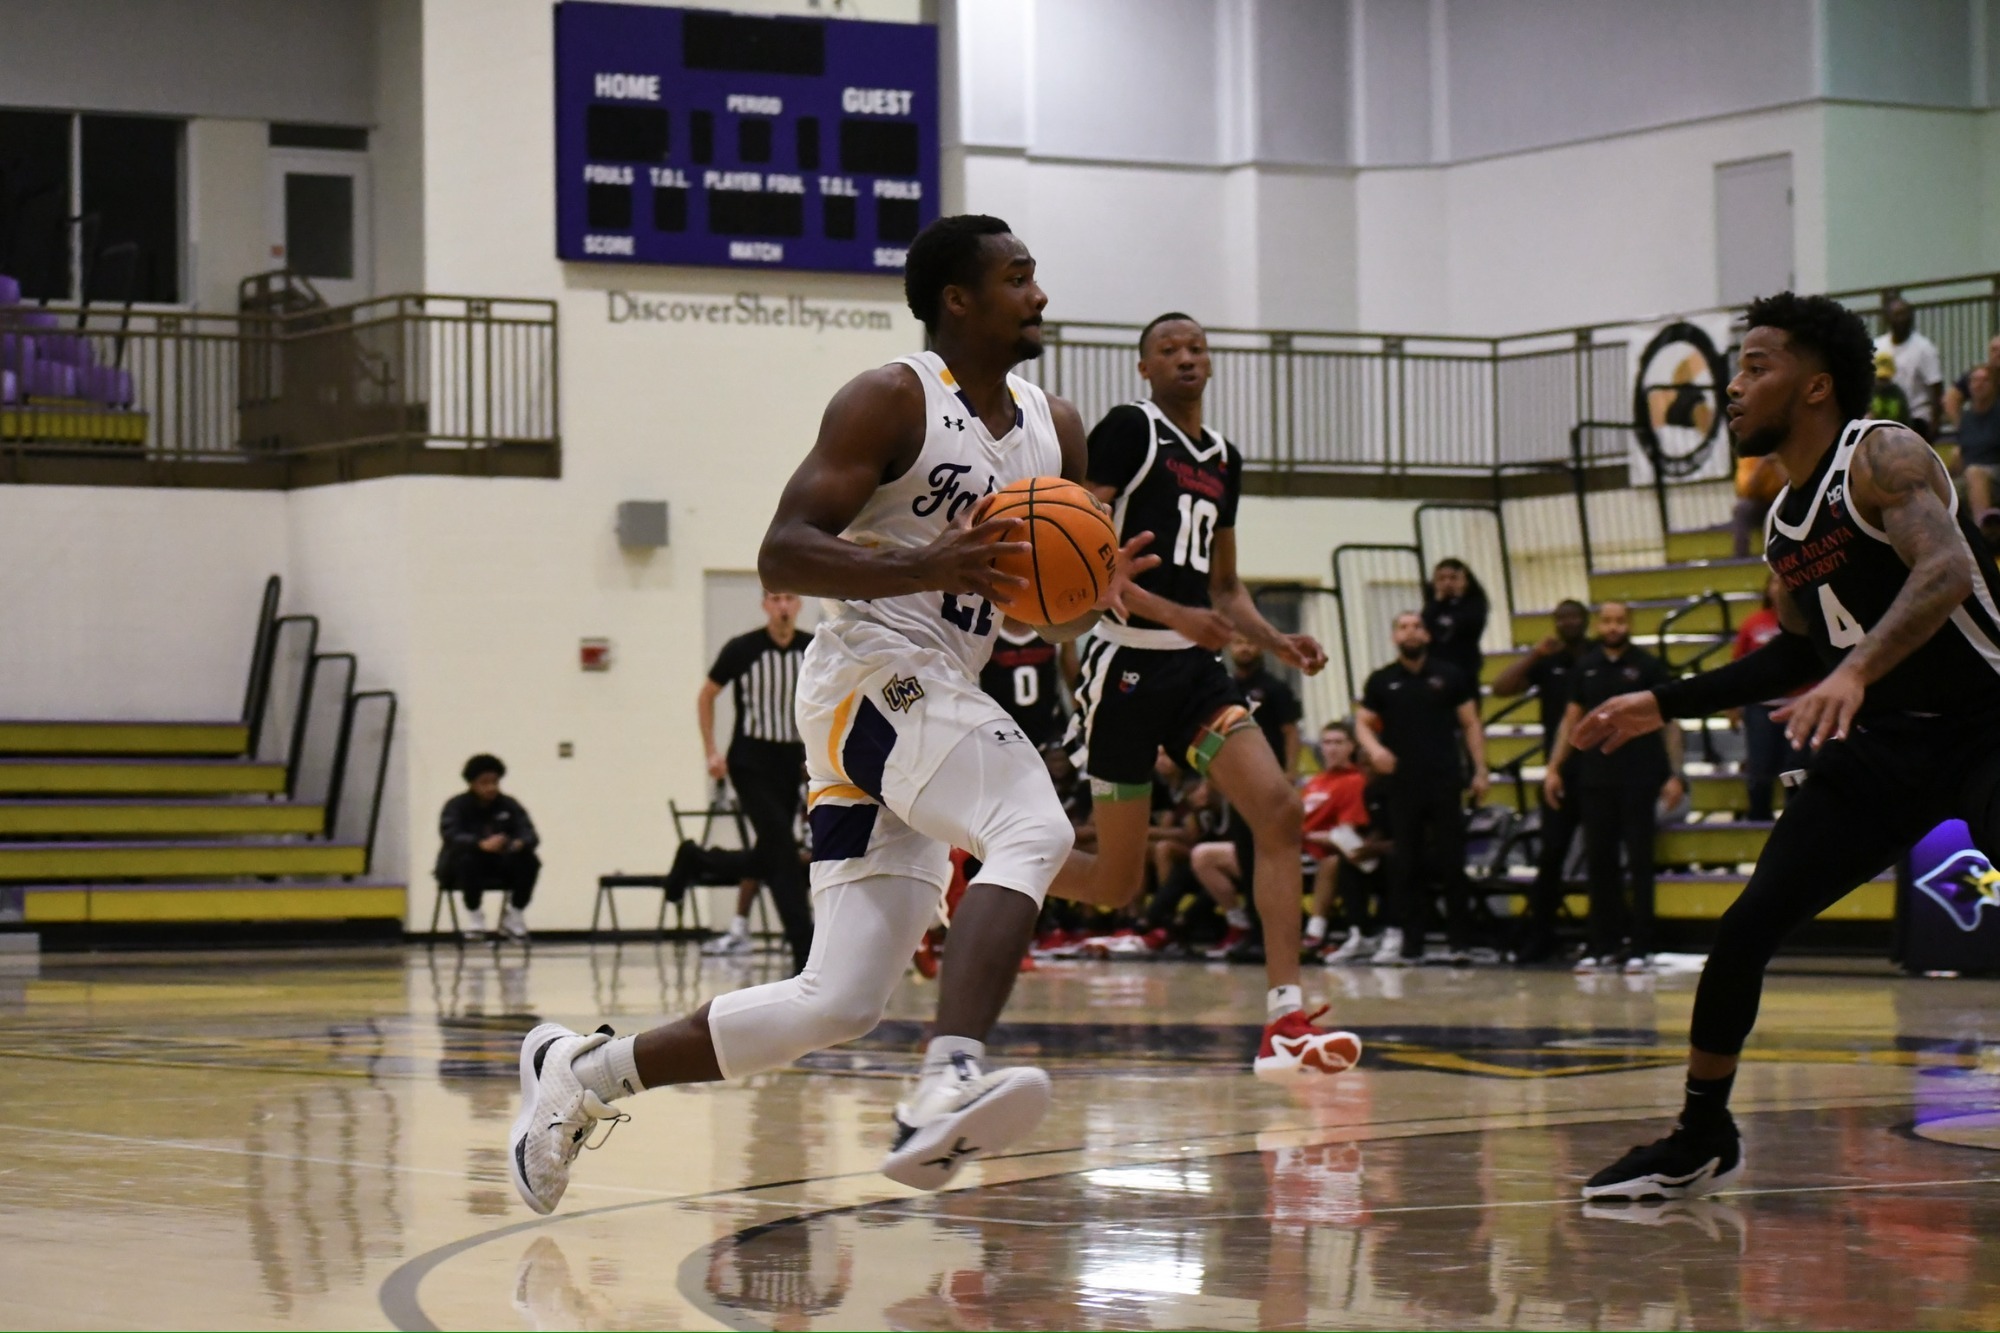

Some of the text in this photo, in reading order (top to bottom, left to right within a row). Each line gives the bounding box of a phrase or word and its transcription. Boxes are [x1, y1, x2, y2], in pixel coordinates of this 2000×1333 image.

[595, 73, 661, 100] HOME
[727, 94, 782, 115] PERIOD
[842, 87, 914, 115] GUEST
[584, 164, 635, 185] FOULS
[704, 170, 804, 194] PLAYER FOUL
[873, 179, 922, 200] FOULS
[584, 235, 634, 255] SCORE
[729, 241, 783, 262] MATCH
[873, 248, 908, 267] SCO
[608, 289, 893, 332] DiscoverShelby.com
[1173, 493, 1218, 574] 10
[1818, 583, 1866, 649] 4
[1013, 666, 1039, 707] 0
